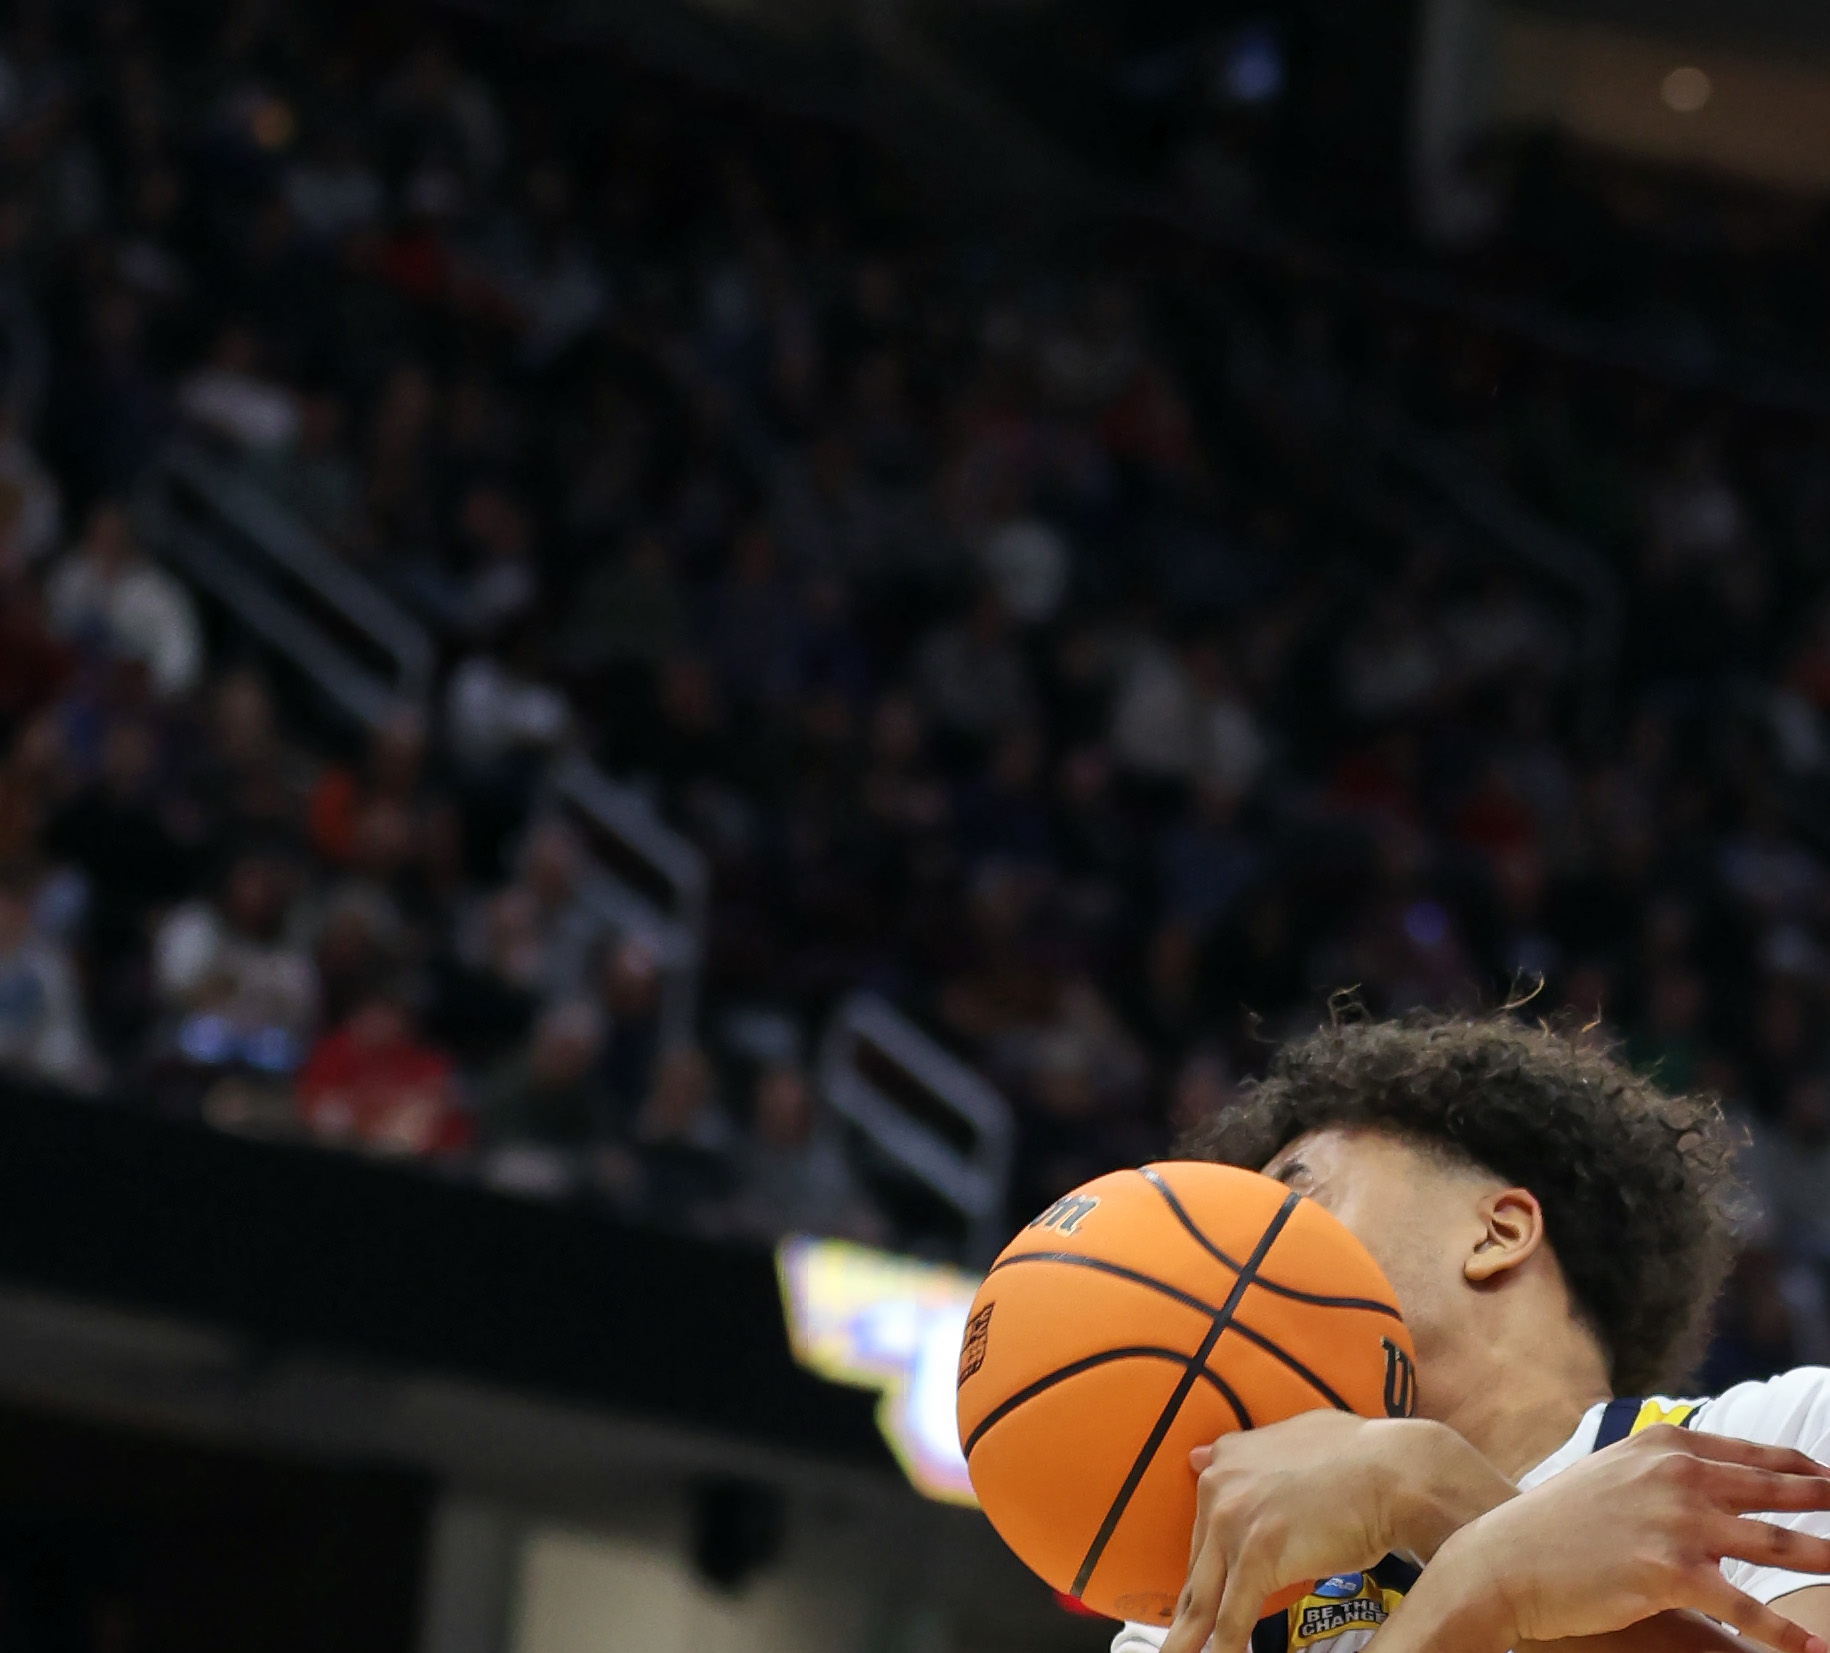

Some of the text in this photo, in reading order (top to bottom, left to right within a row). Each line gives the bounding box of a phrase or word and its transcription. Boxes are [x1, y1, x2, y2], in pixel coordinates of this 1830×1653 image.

[1306, 1599, 1382, 1623] BE THE
[1301, 1611, 1388, 1636] CHANGE
